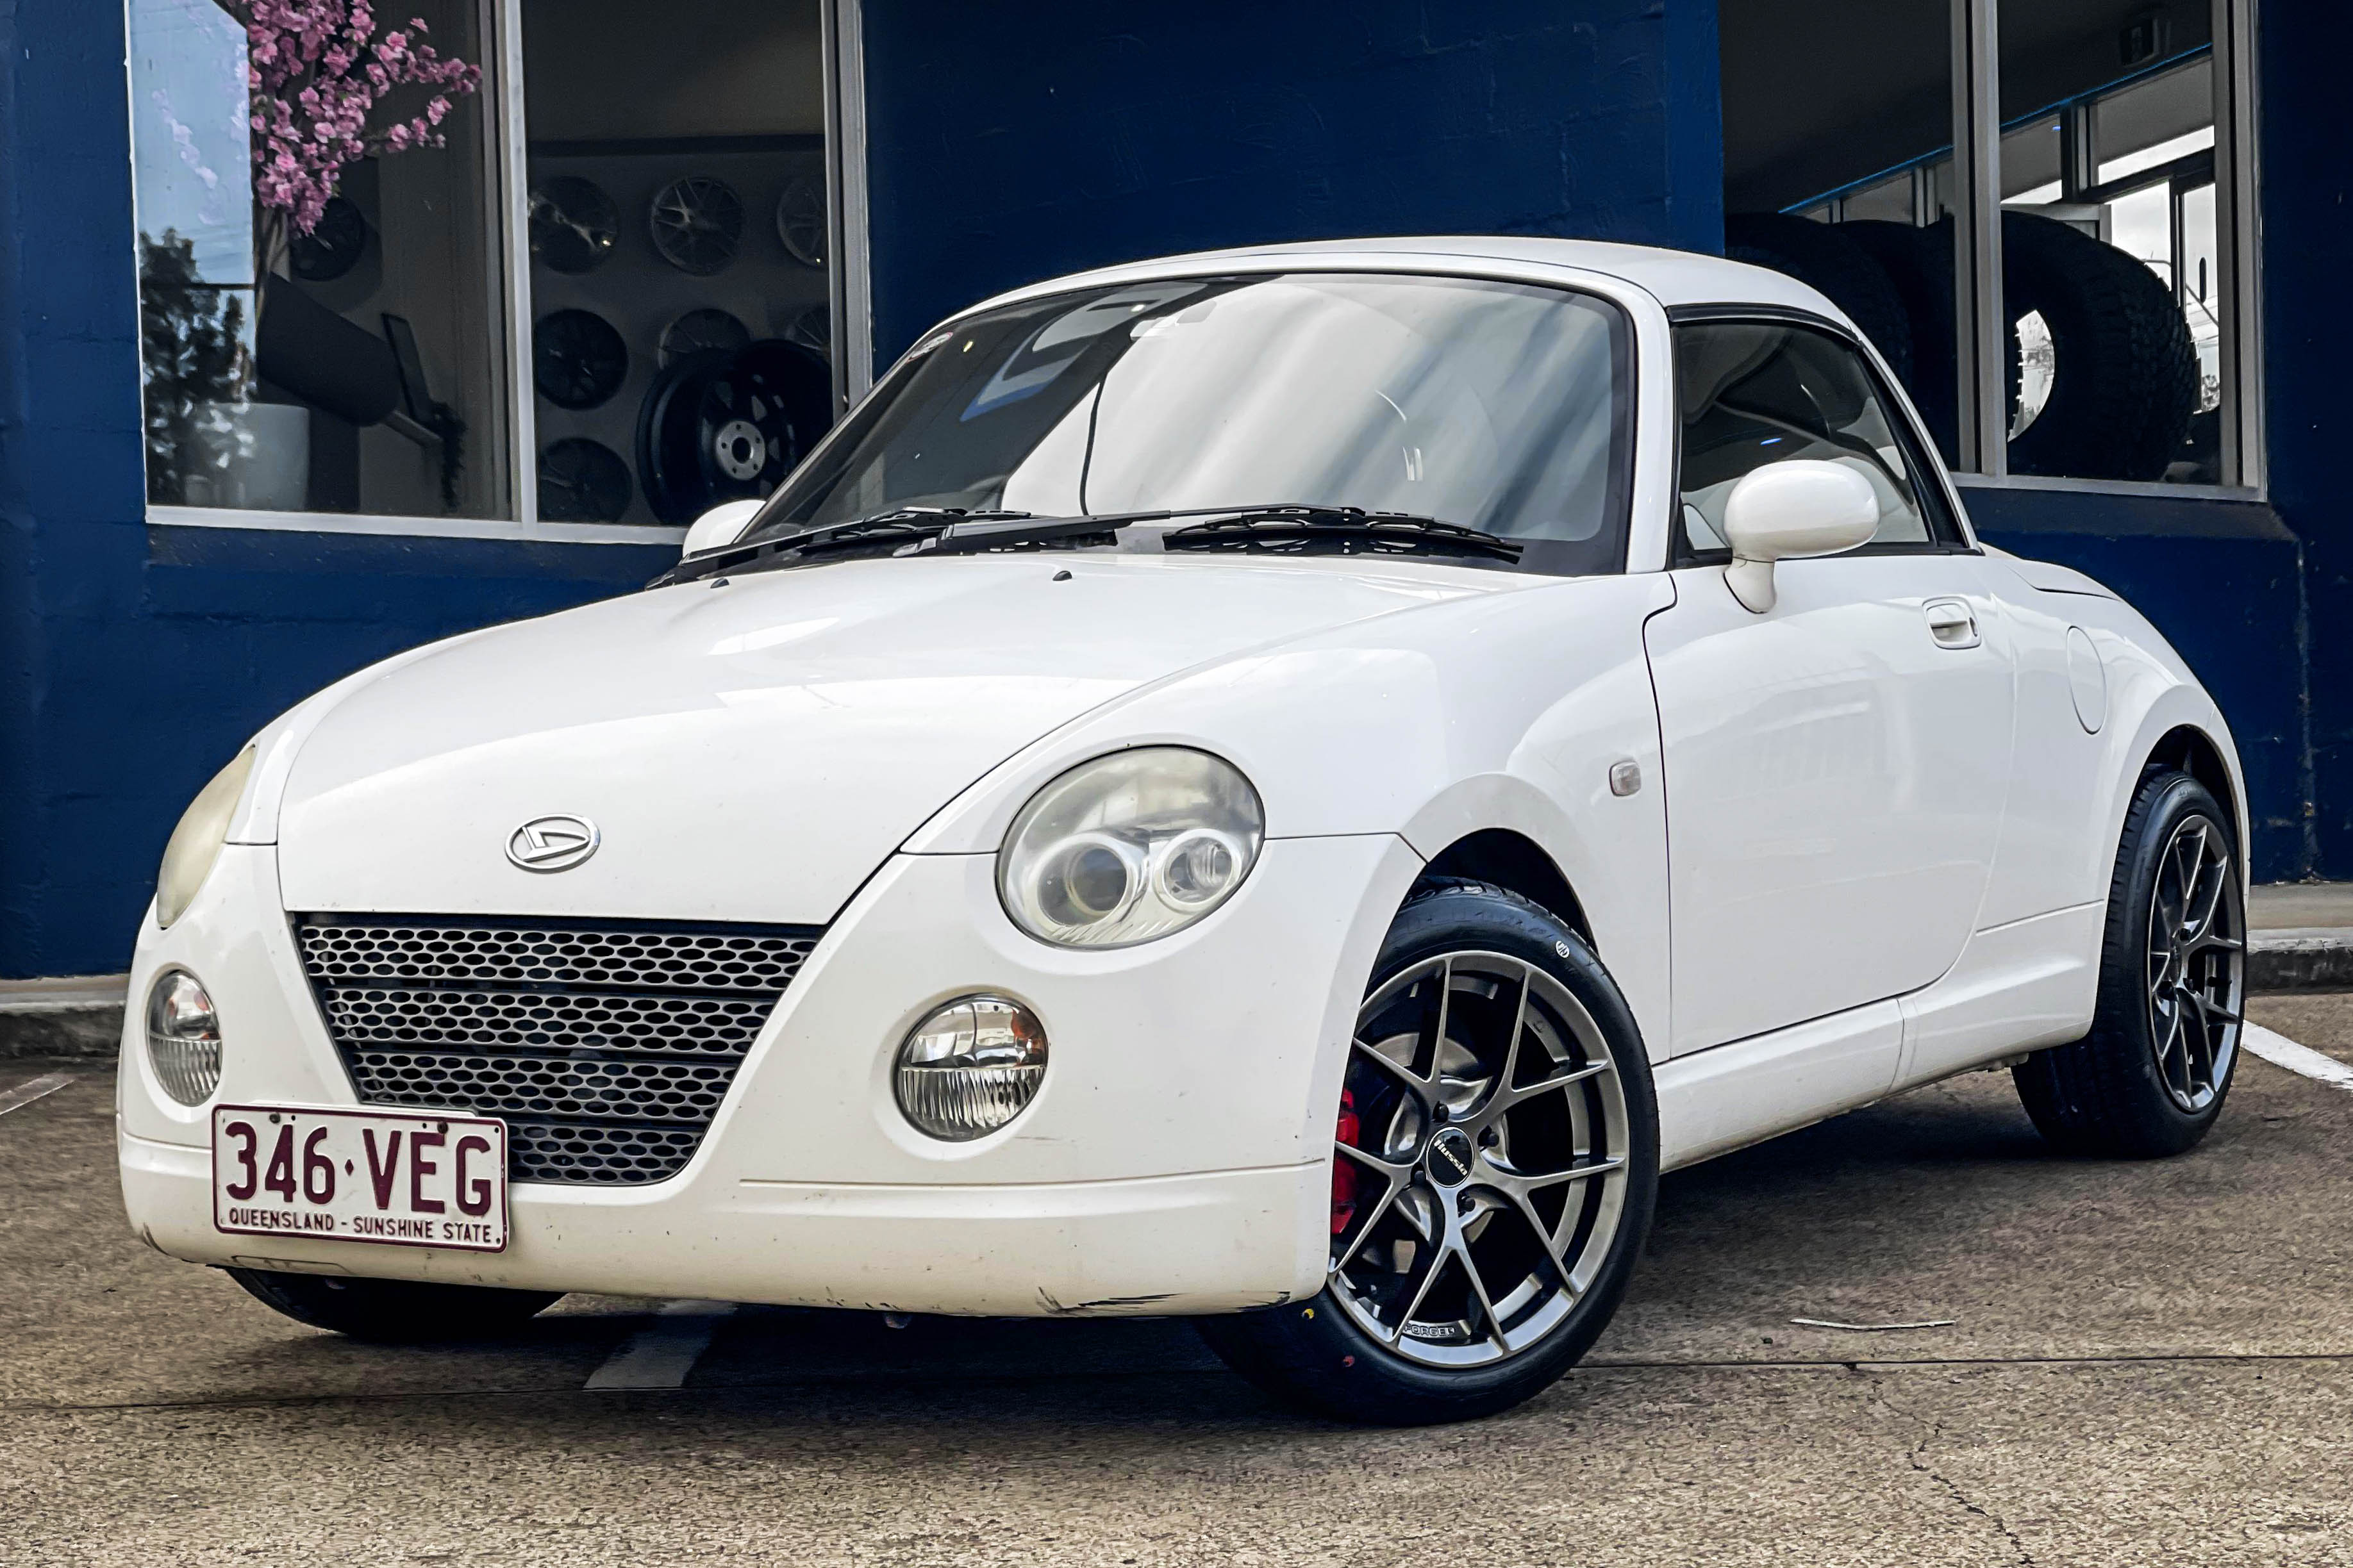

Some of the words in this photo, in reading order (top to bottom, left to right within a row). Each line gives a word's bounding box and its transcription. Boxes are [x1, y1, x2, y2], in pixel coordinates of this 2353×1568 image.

[225, 1121, 335, 1205] 346
[362, 1128, 492, 1216] VEG
[229, 1207, 334, 1232] QUEENSLAND
[354, 1217, 433, 1239] SUNSHINE
[443, 1222, 492, 1243] STATE
